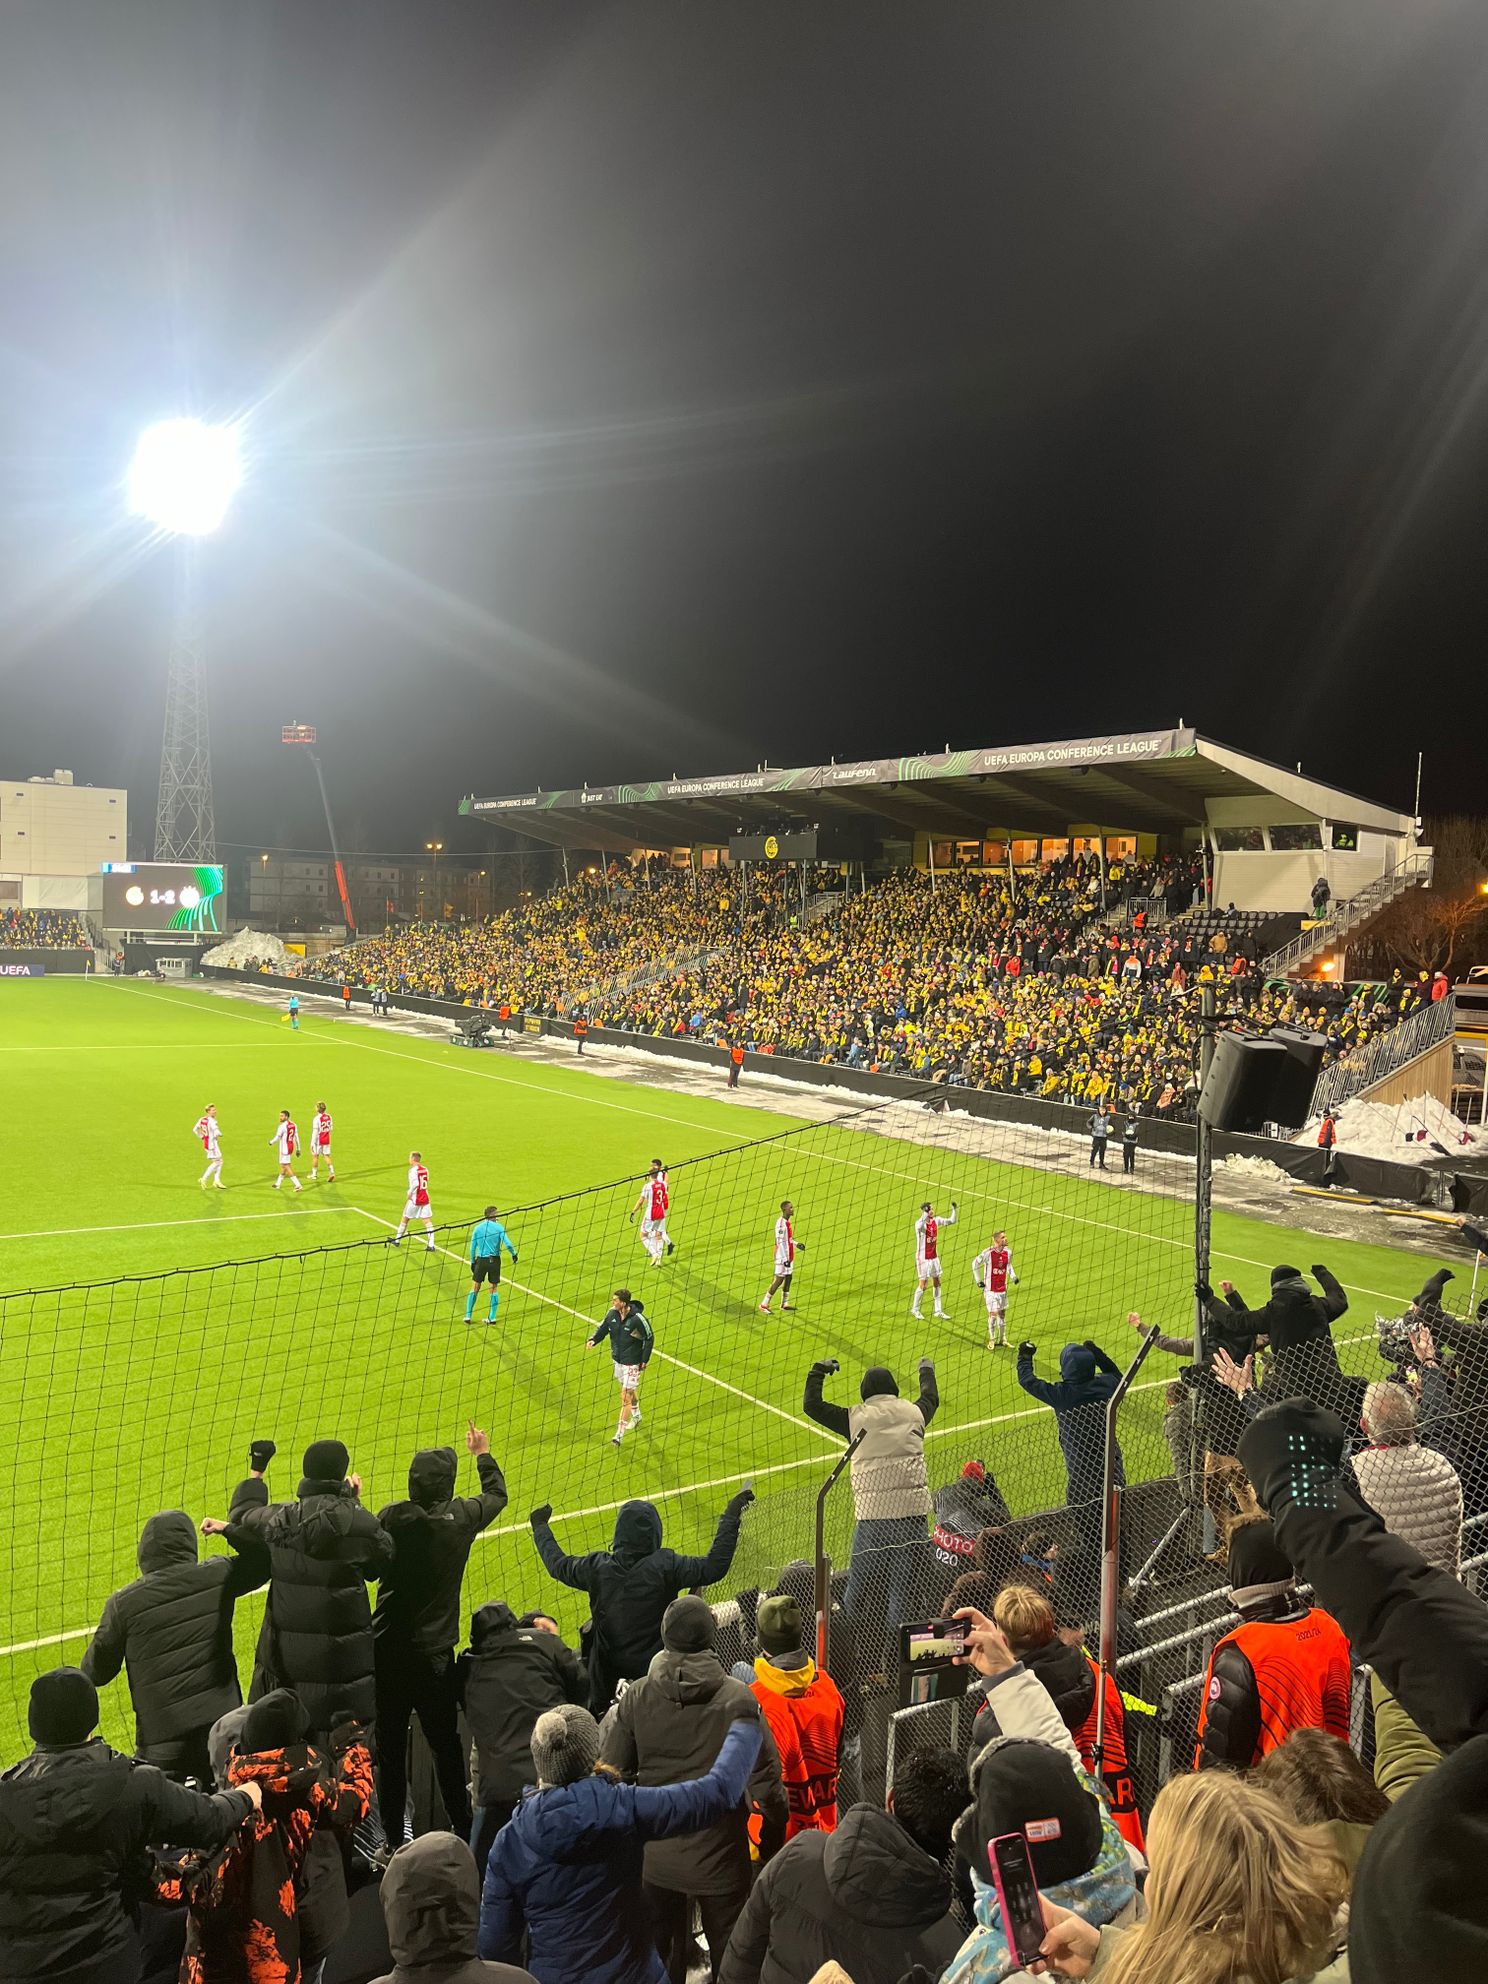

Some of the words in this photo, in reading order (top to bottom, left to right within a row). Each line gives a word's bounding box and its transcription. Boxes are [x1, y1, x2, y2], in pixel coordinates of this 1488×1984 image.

[984, 754, 1008, 766] UEFA
[1009, 751, 1045, 764] EUROPA
[1047, 745, 1114, 761] CONFERENCE
[1117, 740, 1159, 755] LEAGUE
[667, 785, 681, 794] UEFA
[682, 782, 702, 793] EUROPA
[703, 780, 739, 791] CONFERENCE
[741, 778, 764, 788] LEAGUE
[497, 800, 521, 808] CONFERENCE
[522, 798, 537, 806] LEAGUE
[0, 965, 31, 976] UEFA
[288, 1129, 294, 1141] 2
[419, 1175, 428, 1190] 16
[656, 1189, 663, 1205] 3
[935, 1547, 959, 1567] 020
